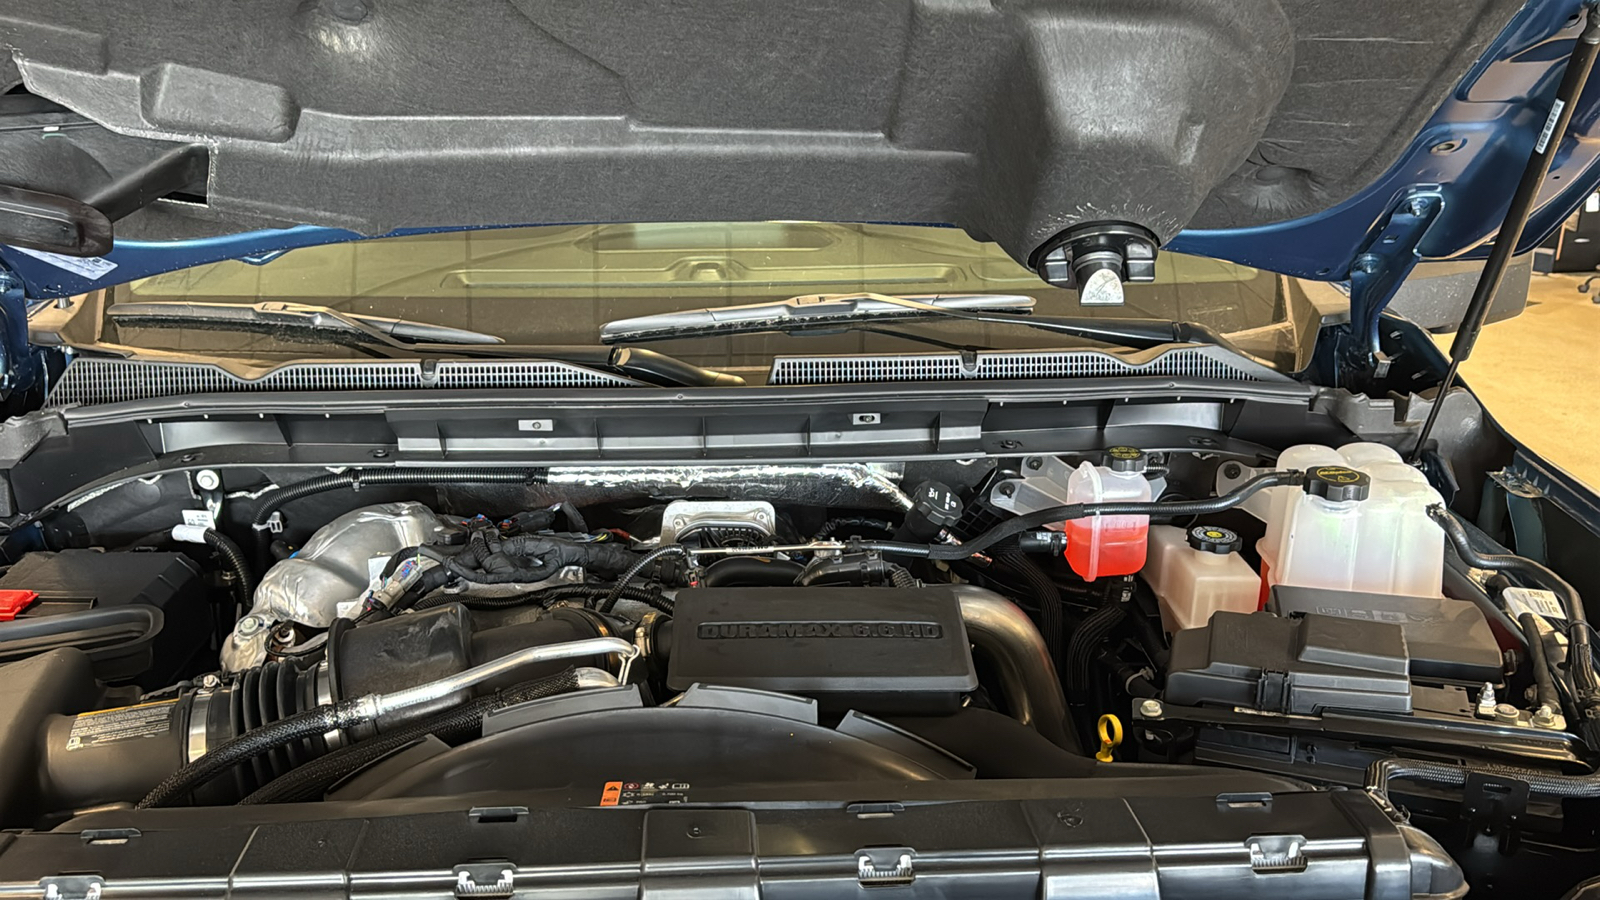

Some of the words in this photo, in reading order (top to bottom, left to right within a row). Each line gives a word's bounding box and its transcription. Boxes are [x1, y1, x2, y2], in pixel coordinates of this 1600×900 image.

[701, 624, 841, 638] DURAMAX
[852, 624, 896, 637] 6.6
[903, 624, 940, 638] HD
